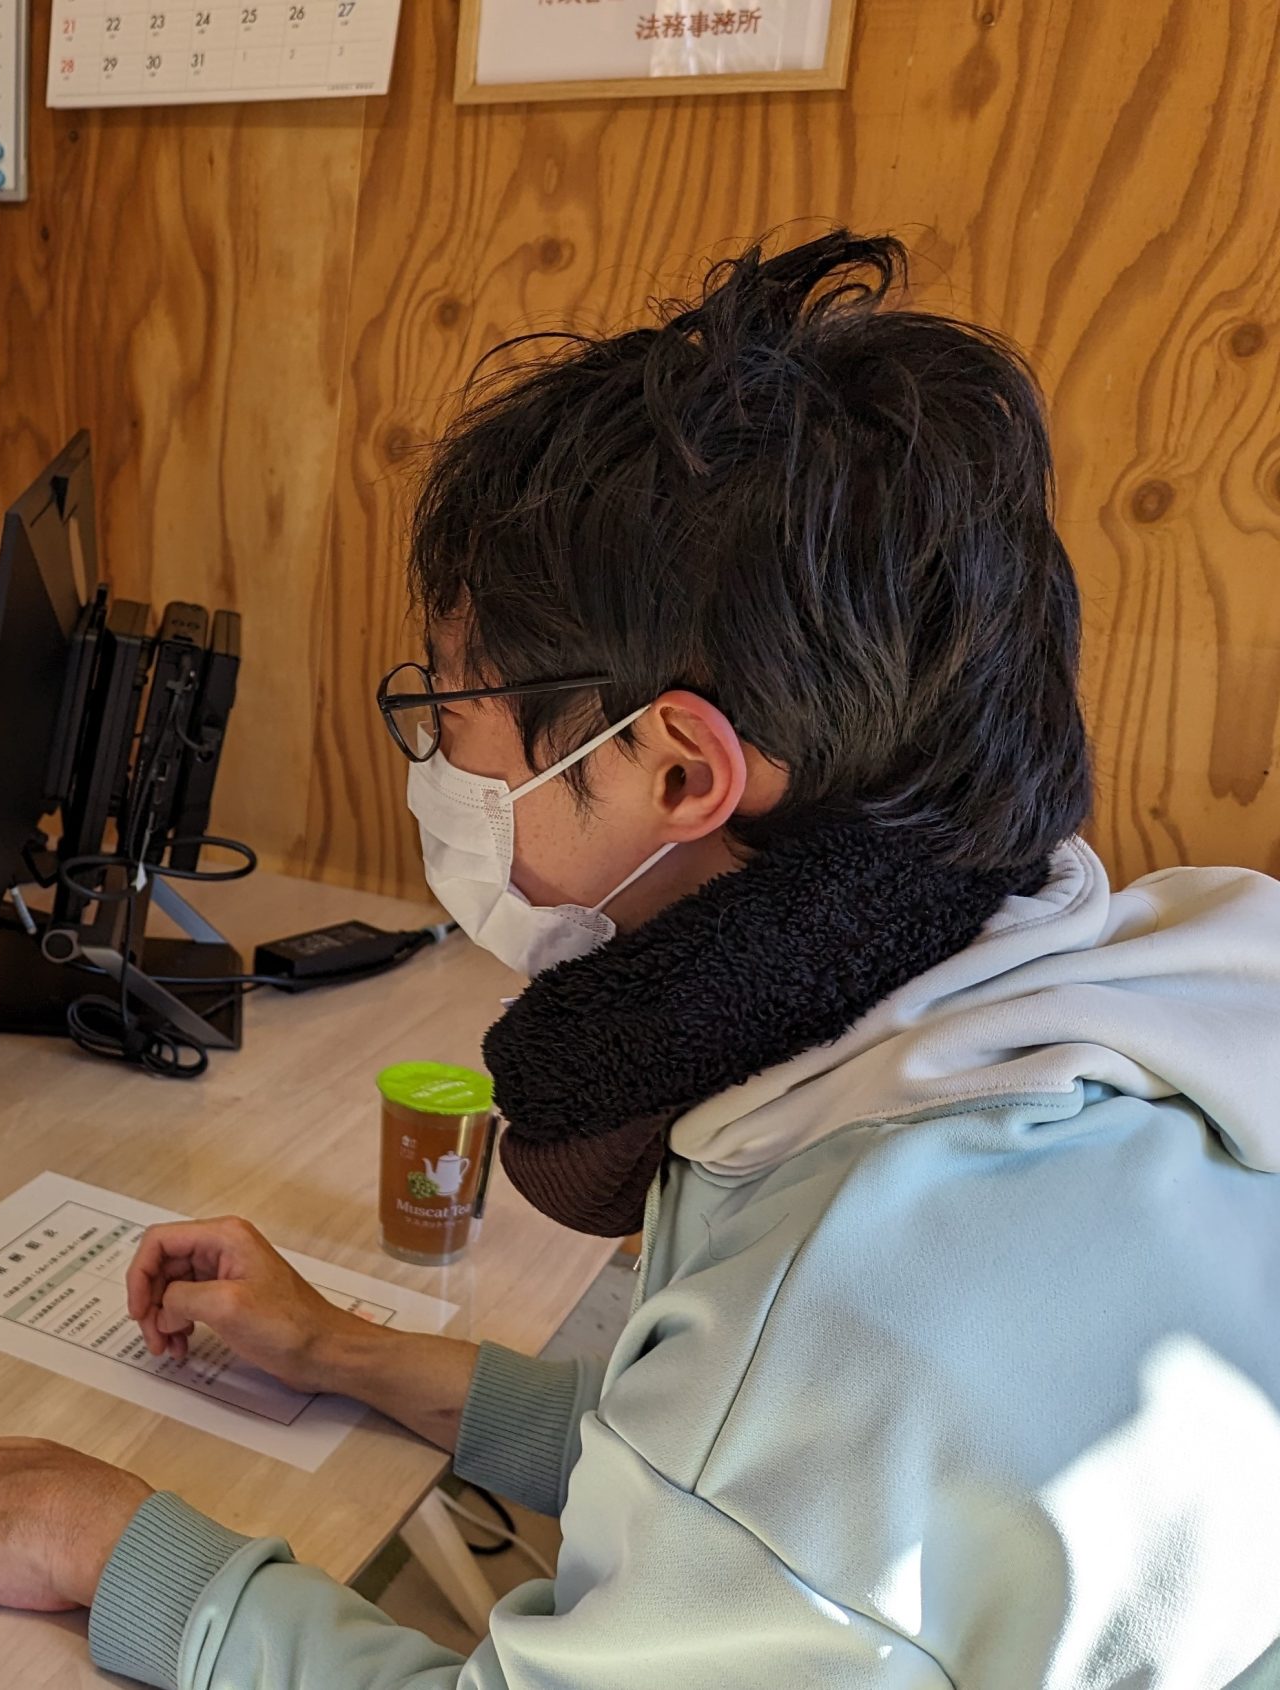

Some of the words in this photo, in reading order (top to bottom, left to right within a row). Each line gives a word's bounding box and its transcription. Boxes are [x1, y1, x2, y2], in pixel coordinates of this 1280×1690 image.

[63, 19, 76, 34] 21
[106, 17, 121, 32] 22
[150, 15, 166, 30] 23
[195, 12, 211, 27] 24
[241, 9, 258, 24] 25
[289, 6, 306, 21] 26
[337, 2, 356, 18] 27
[635, 8, 763, 41] 法務事務所
[61, 59, 75, 74] 28
[103, 57, 118, 72] 29
[146, 55, 162, 70] 30
[190, 53, 205, 68] 31
[396, 1199, 449, 1219] Muscat
